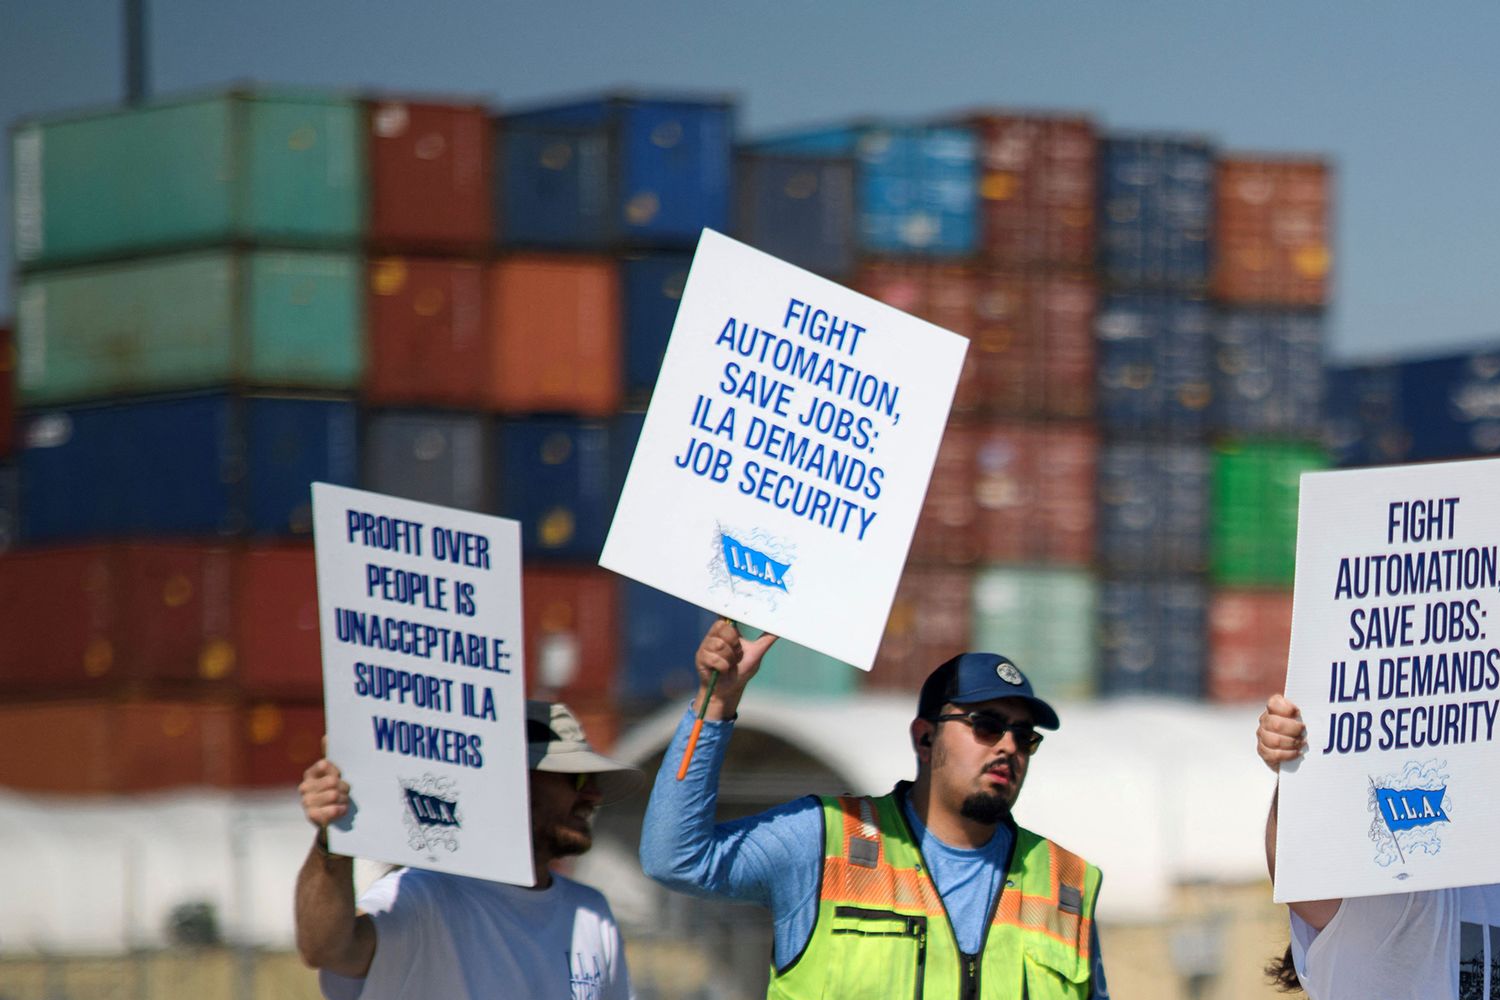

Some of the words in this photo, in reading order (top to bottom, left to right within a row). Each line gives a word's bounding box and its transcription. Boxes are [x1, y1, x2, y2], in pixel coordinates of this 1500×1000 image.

[783, 297, 866, 356] FIGHT
[716, 317, 902, 426] AUTOMATION,
[719, 361, 794, 418] SAVE
[799, 397, 879, 454] JOBS:
[691, 395, 735, 442] ILA
[745, 416, 885, 501] DEMANDS
[674, 438, 733, 484] JOB
[738, 461, 877, 542] SECURITY
[346, 509, 423, 556] PROFIT
[432, 526, 490, 569] OVER
[1388, 497, 1460, 544] FIGHT
[366, 564, 447, 612] PEOPLE
[455, 581, 476, 617] IS
[335, 608, 511, 674] UNACCEPTABLE:
[1349, 605, 1415, 651] SAVE
[1420, 599, 1487, 644] JOBS:
[354, 662, 453, 714] SUPPORT
[461, 683, 497, 722] ILA
[1329, 660, 1369, 703] ILA
[1378, 649, 1500, 700] DEMANDS
[372, 715, 482, 769] WORKERS
[1323, 711, 1372, 754] JOB
[1378, 700, 1500, 750] SECURITY
[1388, 796, 1440, 822] I.L.A.
